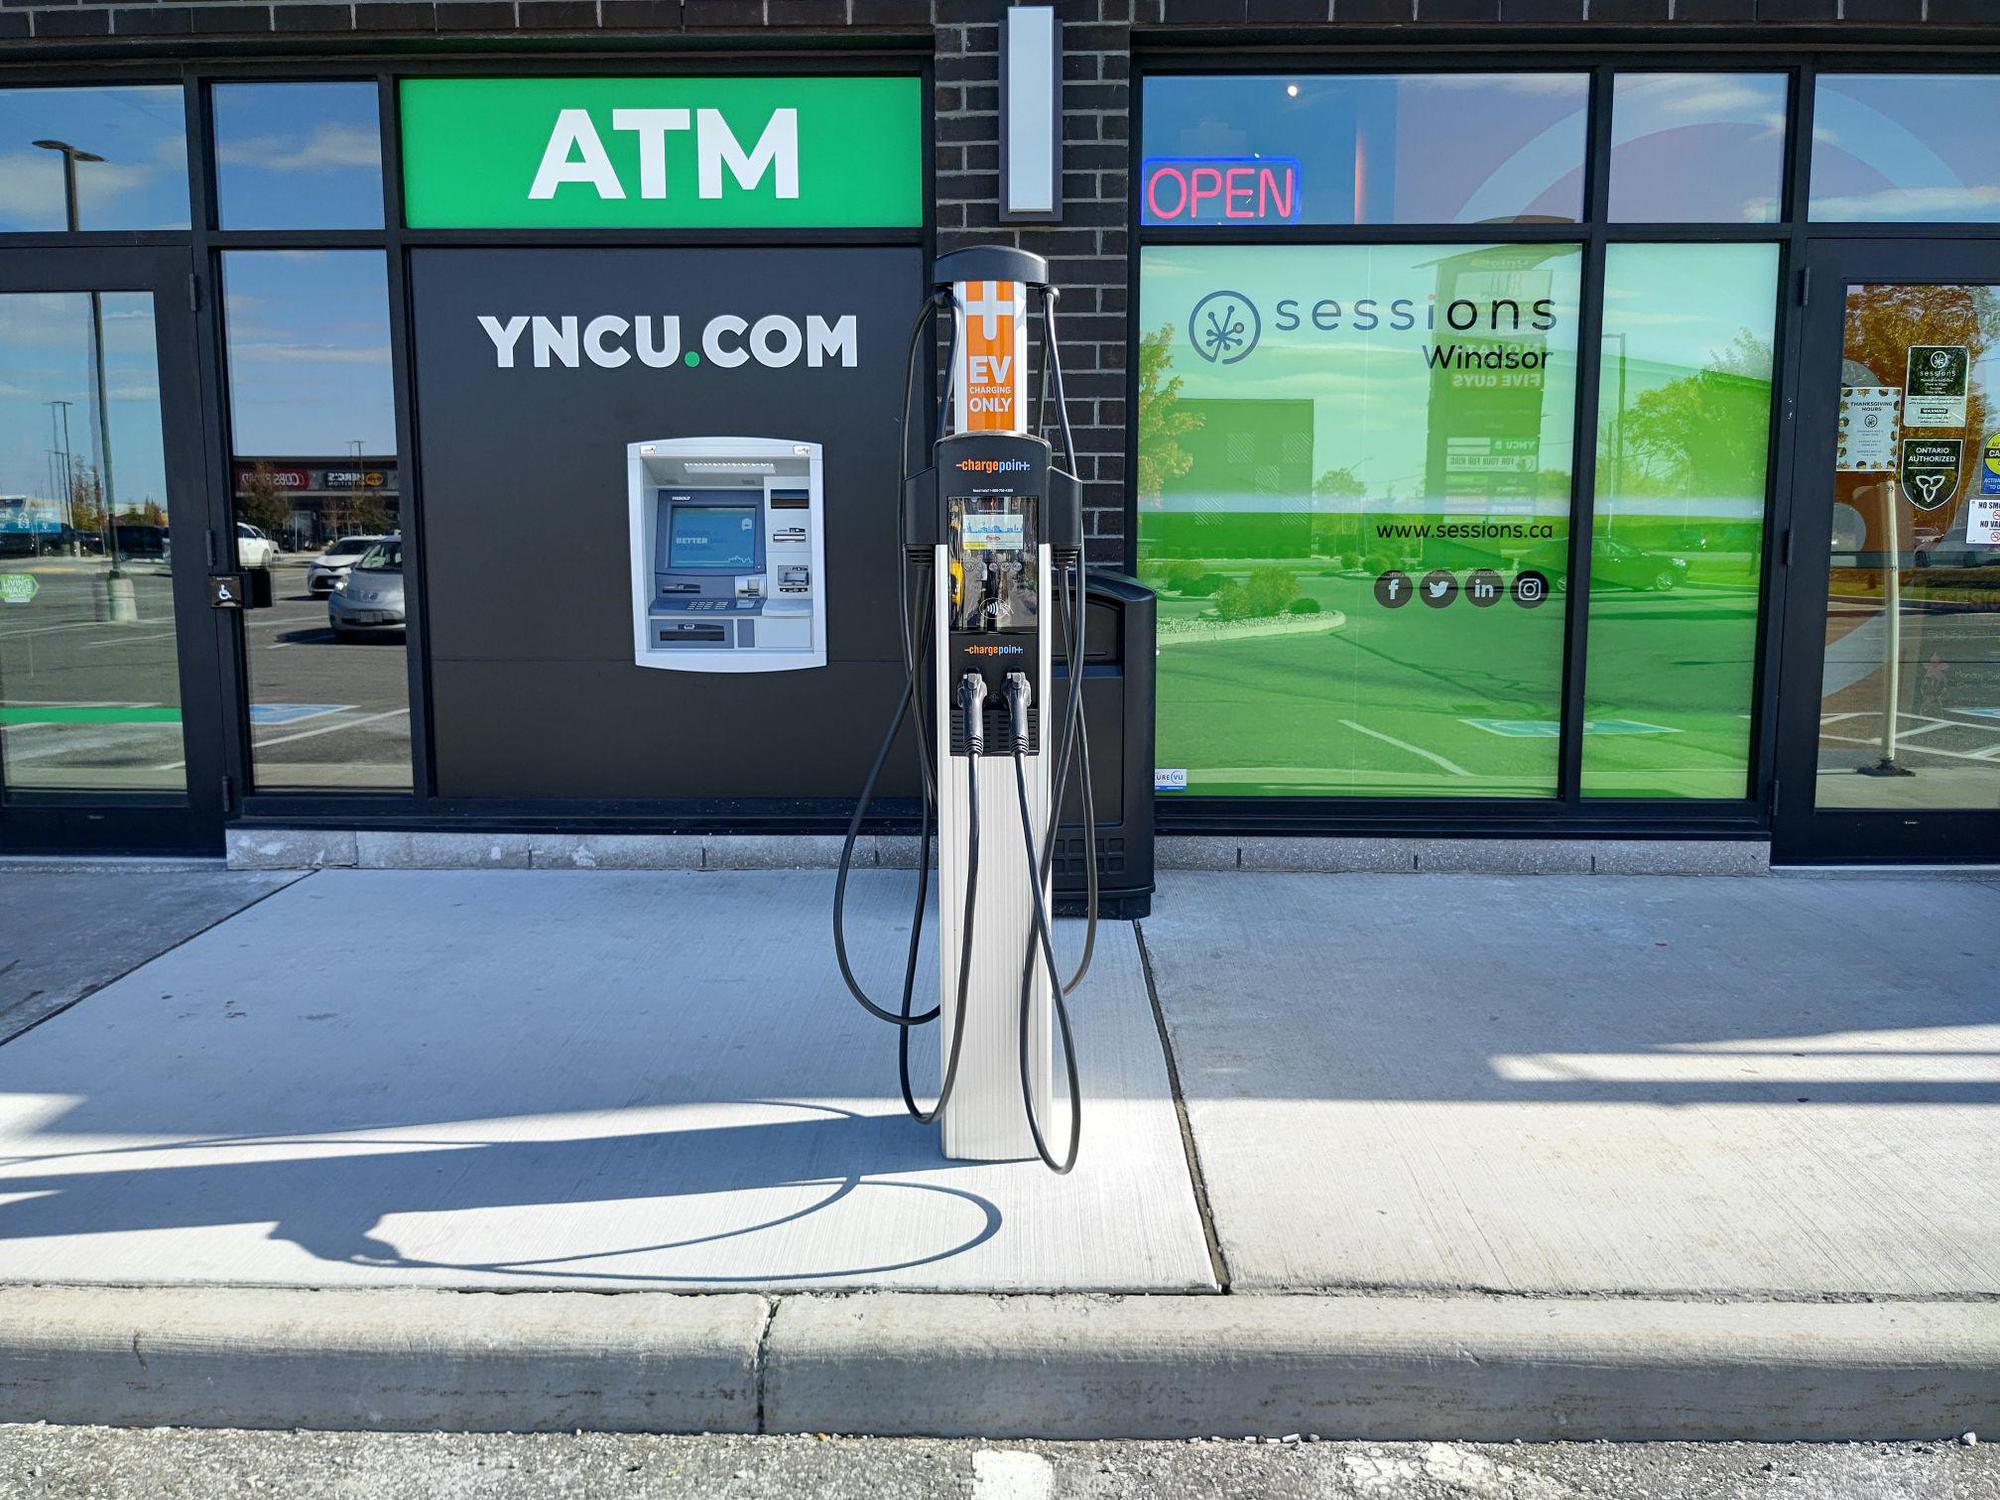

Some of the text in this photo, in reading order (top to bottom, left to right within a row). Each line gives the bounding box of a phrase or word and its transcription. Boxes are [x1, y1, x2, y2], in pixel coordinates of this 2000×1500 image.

[527, 108, 800, 199] ATM
[1148, 168, 1293, 219] OPEN
[1276, 294, 1558, 331] sessions
[477, 314, 858, 369] YNCU.COM
[1422, 344, 1554, 369] Windsor
[969, 356, 1012, 384] EV
[969, 386, 1012, 394] CHARGING
[969, 398, 1012, 413] ONLY
[1908, 455, 1956, 463] AUTHORIZED
[1978, 501, 1988, 509] NO
[1376, 521, 1553, 539] www.sessions.ca
[1979, 520, 1988, 528] NO
[676, 537, 708, 545] BETTER
